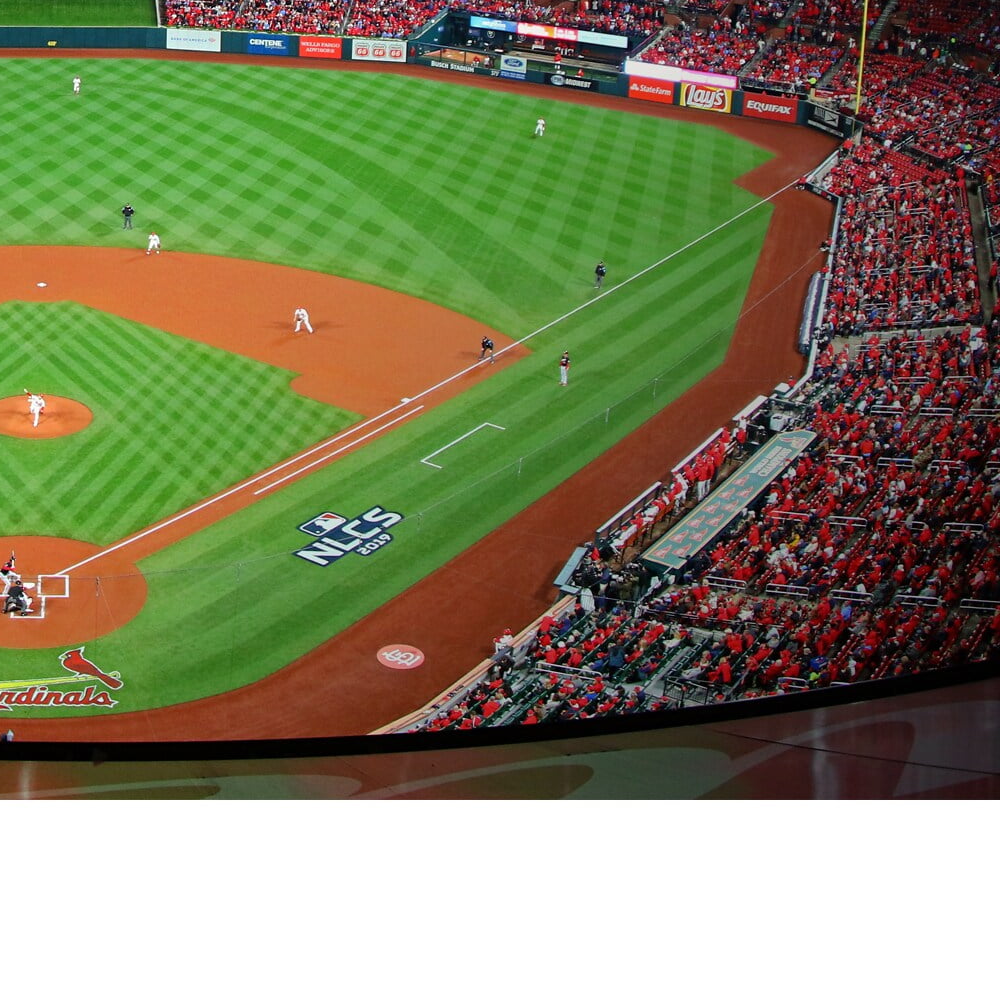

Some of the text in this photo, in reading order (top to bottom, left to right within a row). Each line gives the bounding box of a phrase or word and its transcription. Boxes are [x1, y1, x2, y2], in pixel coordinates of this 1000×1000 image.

[249, 38, 284, 47] CENTENE
[431, 60, 475, 73] BUSCH STADIUM
[506, 59, 521, 67] Ford
[686, 85, 725, 109] Lay's
[746, 100, 792, 115] EQUIFAX
[296, 506, 402, 566] NLCS
[356, 533, 391, 556] 2019
